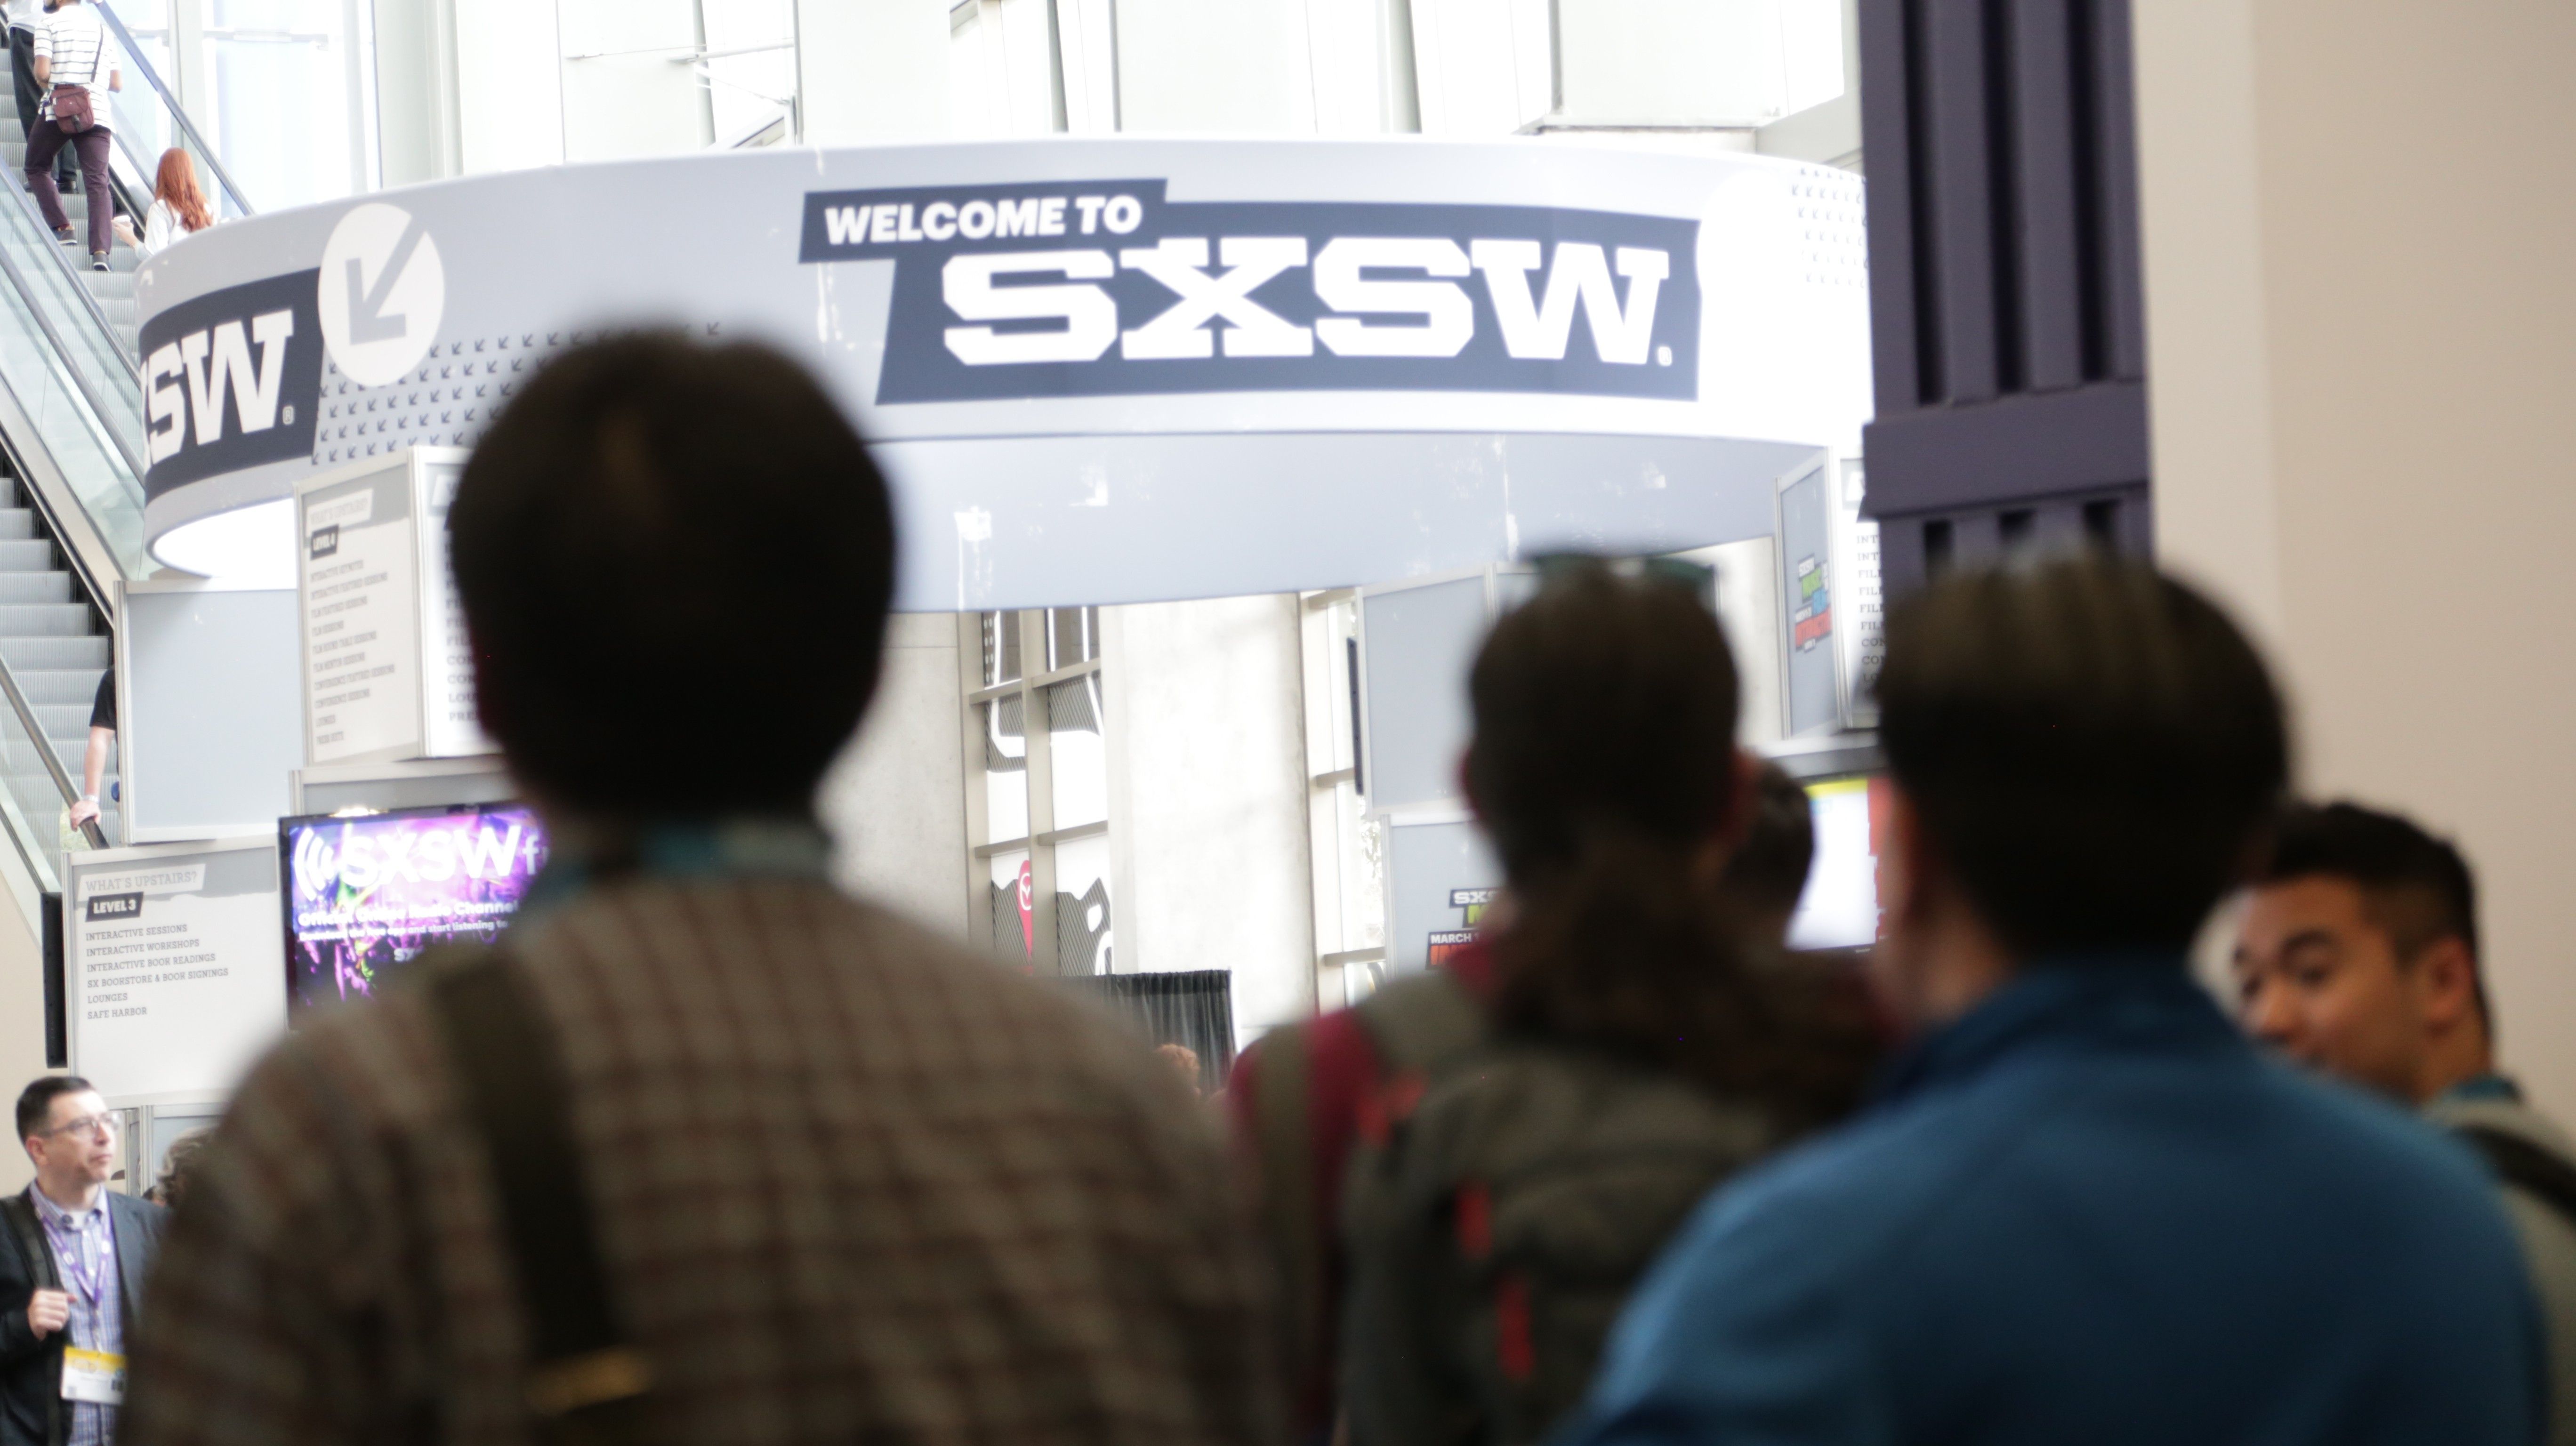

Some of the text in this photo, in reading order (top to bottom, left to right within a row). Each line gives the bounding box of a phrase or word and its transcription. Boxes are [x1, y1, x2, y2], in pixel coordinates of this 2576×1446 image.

[825, 194, 1143, 245] WELCOME TO
[942, 237, 1670, 365] SXSW
[86, 871, 197, 892] WHAT'S UPSTAIRS?
[94, 900, 137, 914] LEVEL 3
[453, 900, 518, 915] Channel
[86, 924, 187, 941] INTERACTIVE SESSIONS
[408, 924, 426, 933] and
[428, 923, 451, 932] start
[452, 920, 494, 931] listening
[1431, 933, 1472, 944] MARCH
[86, 939, 200, 956] INTERACTIVE WORKSHOPS
[87, 953, 216, 972] INTERACTIVE BOOK READINGS
[88, 968, 228, 988] SX BOOKSTORE & BOOK SIGNINGS
[88, 992, 128, 1004] LOUNGES
[88, 1006, 147, 1020] SAFE HARBOR
